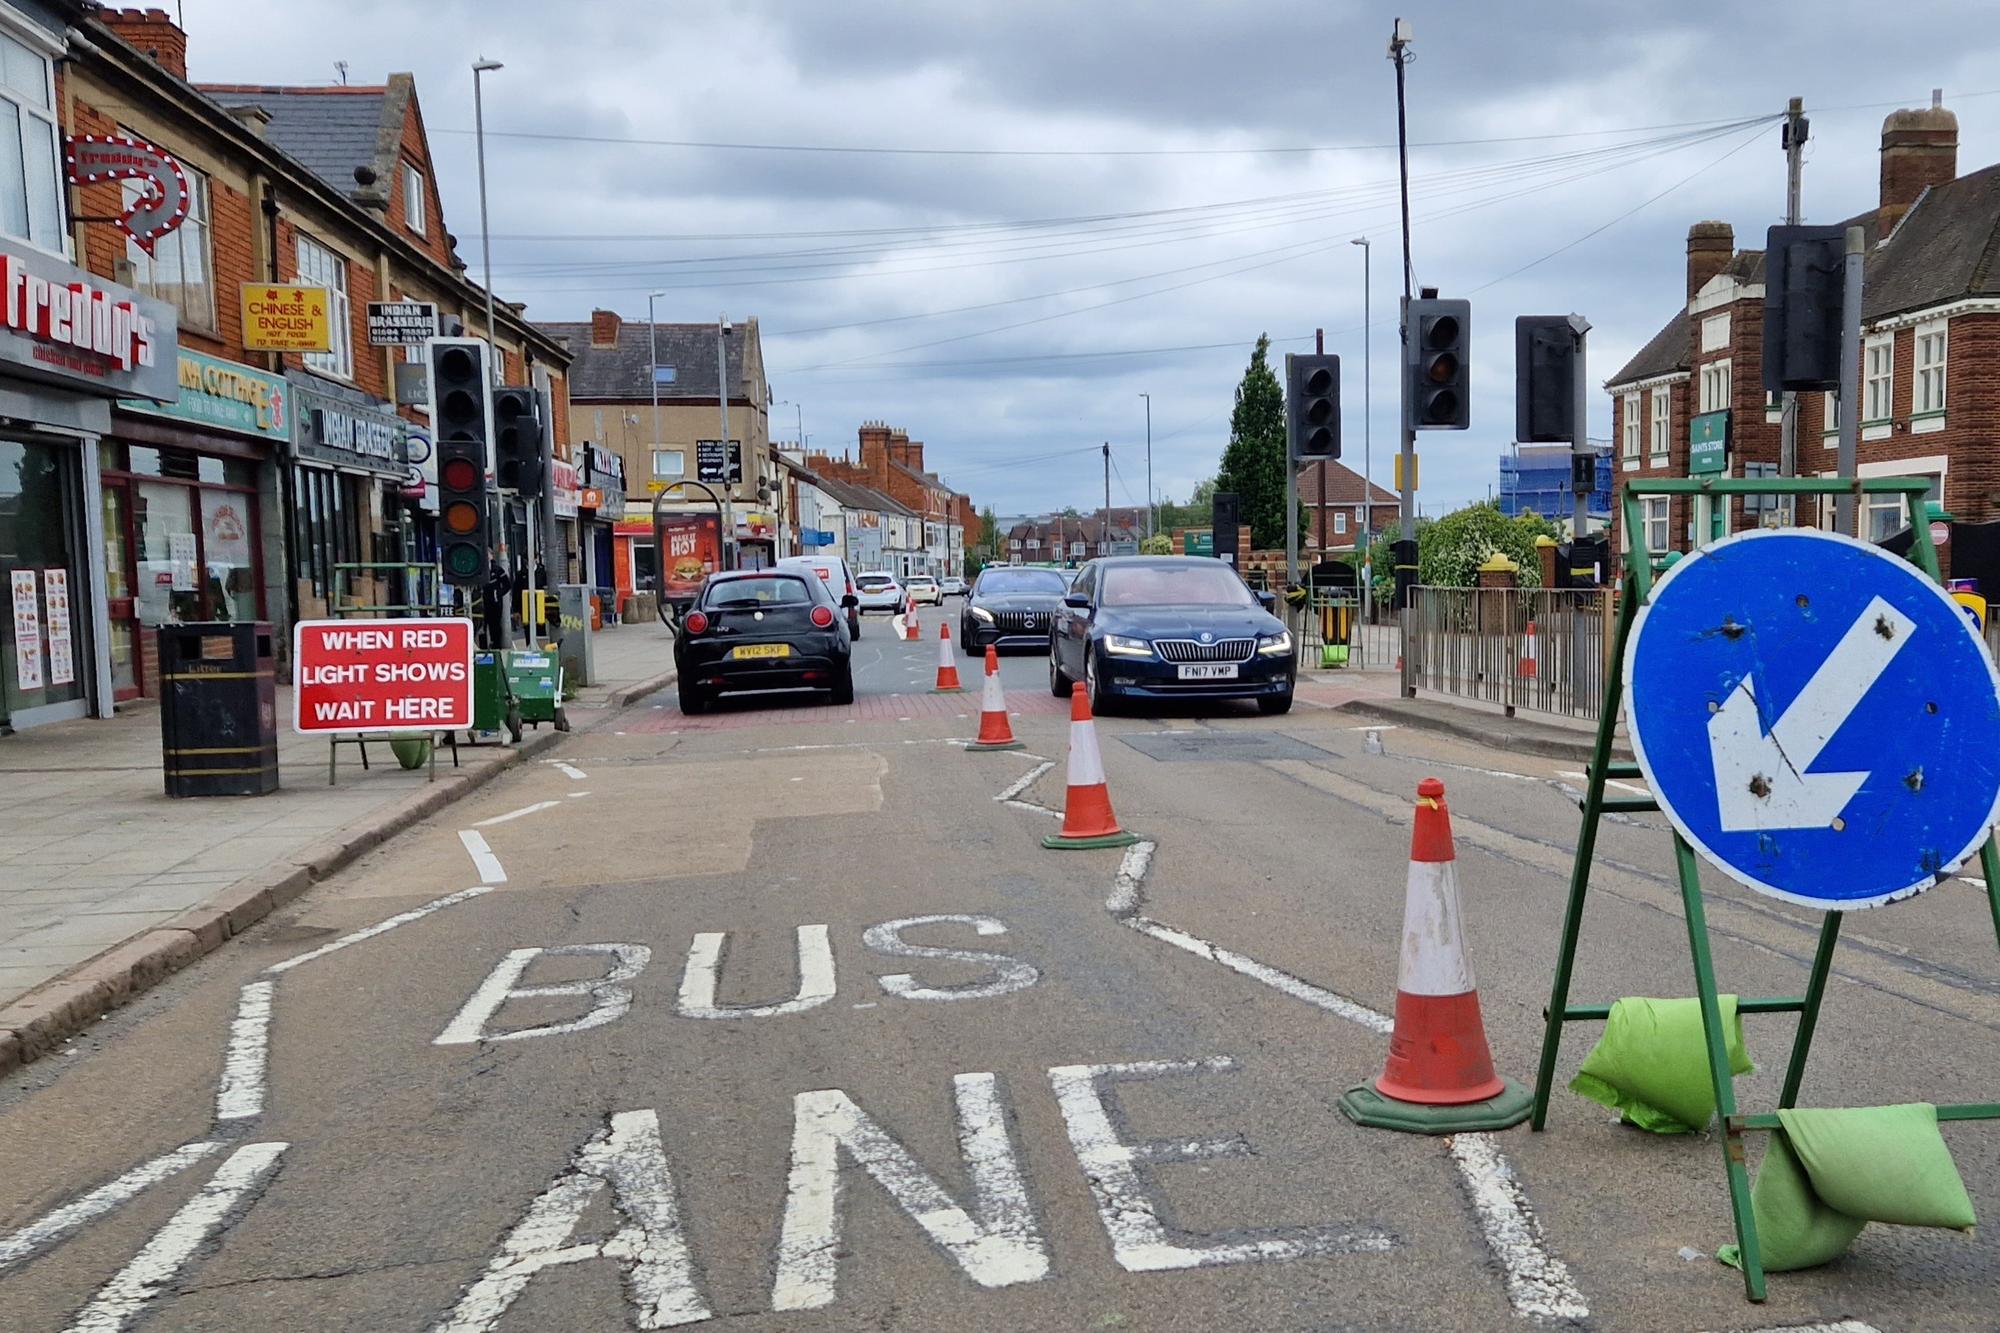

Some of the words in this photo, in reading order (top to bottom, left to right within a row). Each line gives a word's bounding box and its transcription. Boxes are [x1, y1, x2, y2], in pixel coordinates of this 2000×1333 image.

[6, 255, 157, 372] Freddy's
[249, 302, 305, 316] CHINESE
[311, 304, 323, 317] &
[381, 305, 422, 316] INDIAN
[258, 317, 314, 330] ENGLISH
[370, 316, 433, 328] BRASSERIE
[204, 364, 271, 431] COTTAGE
[671, 539, 696, 556] HOT
[322, 631, 394, 651] WHEN
[402, 629, 448, 648] RED
[302, 665, 369, 685] LIGHT
[375, 662, 466, 682] SHOWS
[1184, 666, 1208, 677] FN17
[1211, 666, 1231, 676] VMP
[314, 701, 376, 721] WAIT
[385, 697, 455, 719] HERE
[433, 914, 1041, 1045] BUS
